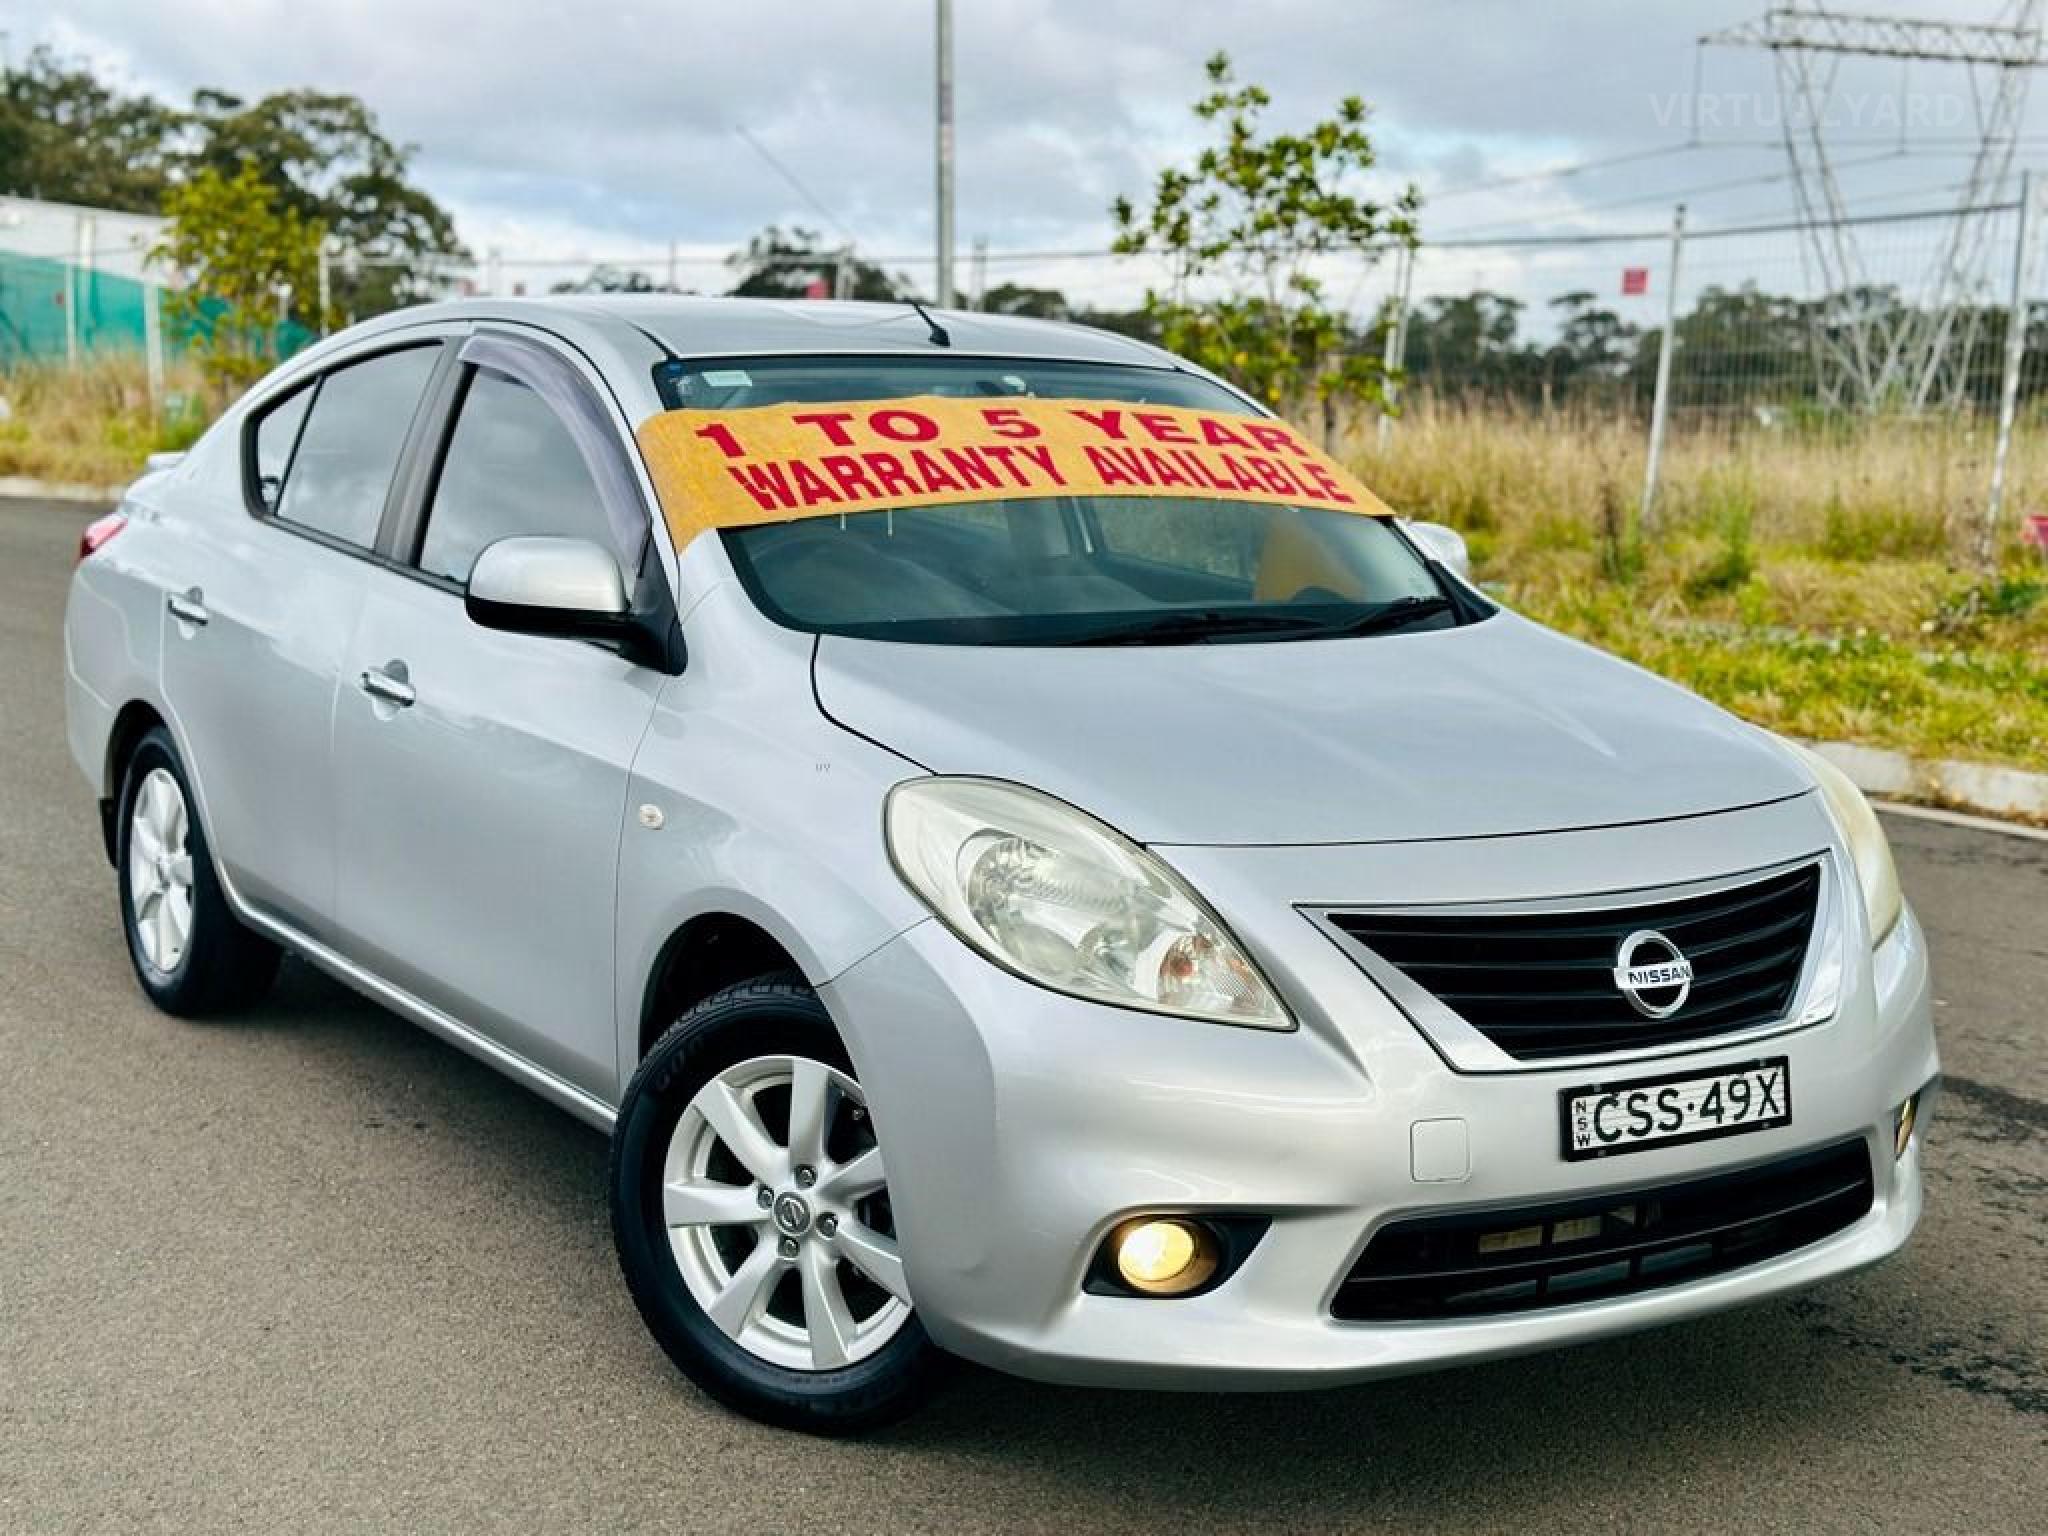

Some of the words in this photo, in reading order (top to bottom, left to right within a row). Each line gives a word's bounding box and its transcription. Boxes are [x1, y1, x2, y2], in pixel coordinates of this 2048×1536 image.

[696, 423, 745, 459] 1
[793, 410, 940, 447] TO
[980, 408, 1042, 440] 5
[1072, 409, 1308, 457] YEAR
[728, 446, 1066, 511] WARRANTY
[1082, 446, 1352, 504] AVAILABLE
[1627, 965, 1690, 985] NISSAN
